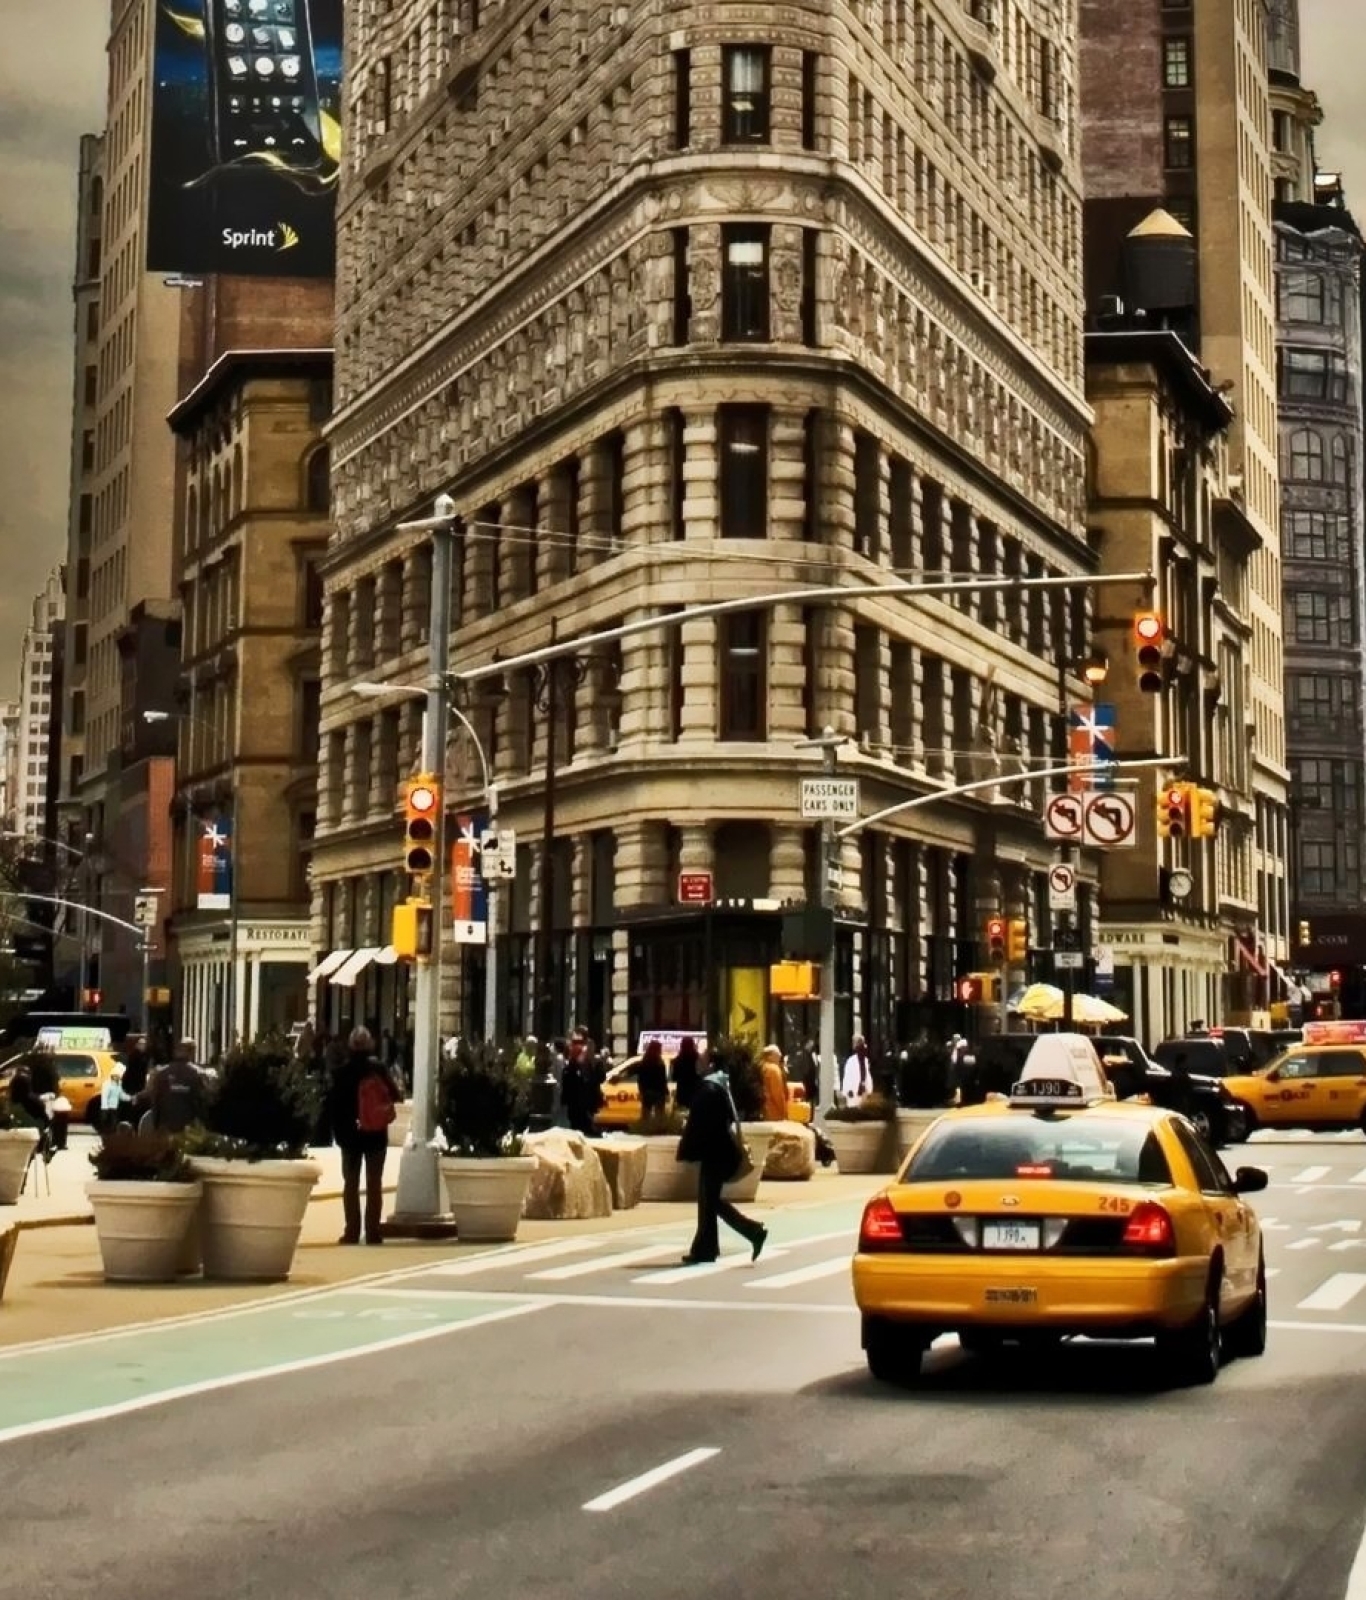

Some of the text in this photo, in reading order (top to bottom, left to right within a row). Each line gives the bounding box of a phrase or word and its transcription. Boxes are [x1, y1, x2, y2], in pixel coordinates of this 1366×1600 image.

[222, 227, 275, 249] Sprint
[803, 784, 854, 796] PASSENGER
[804, 800, 854, 812] CARS ONLY
[1098, 1196, 1130, 1213] 245
